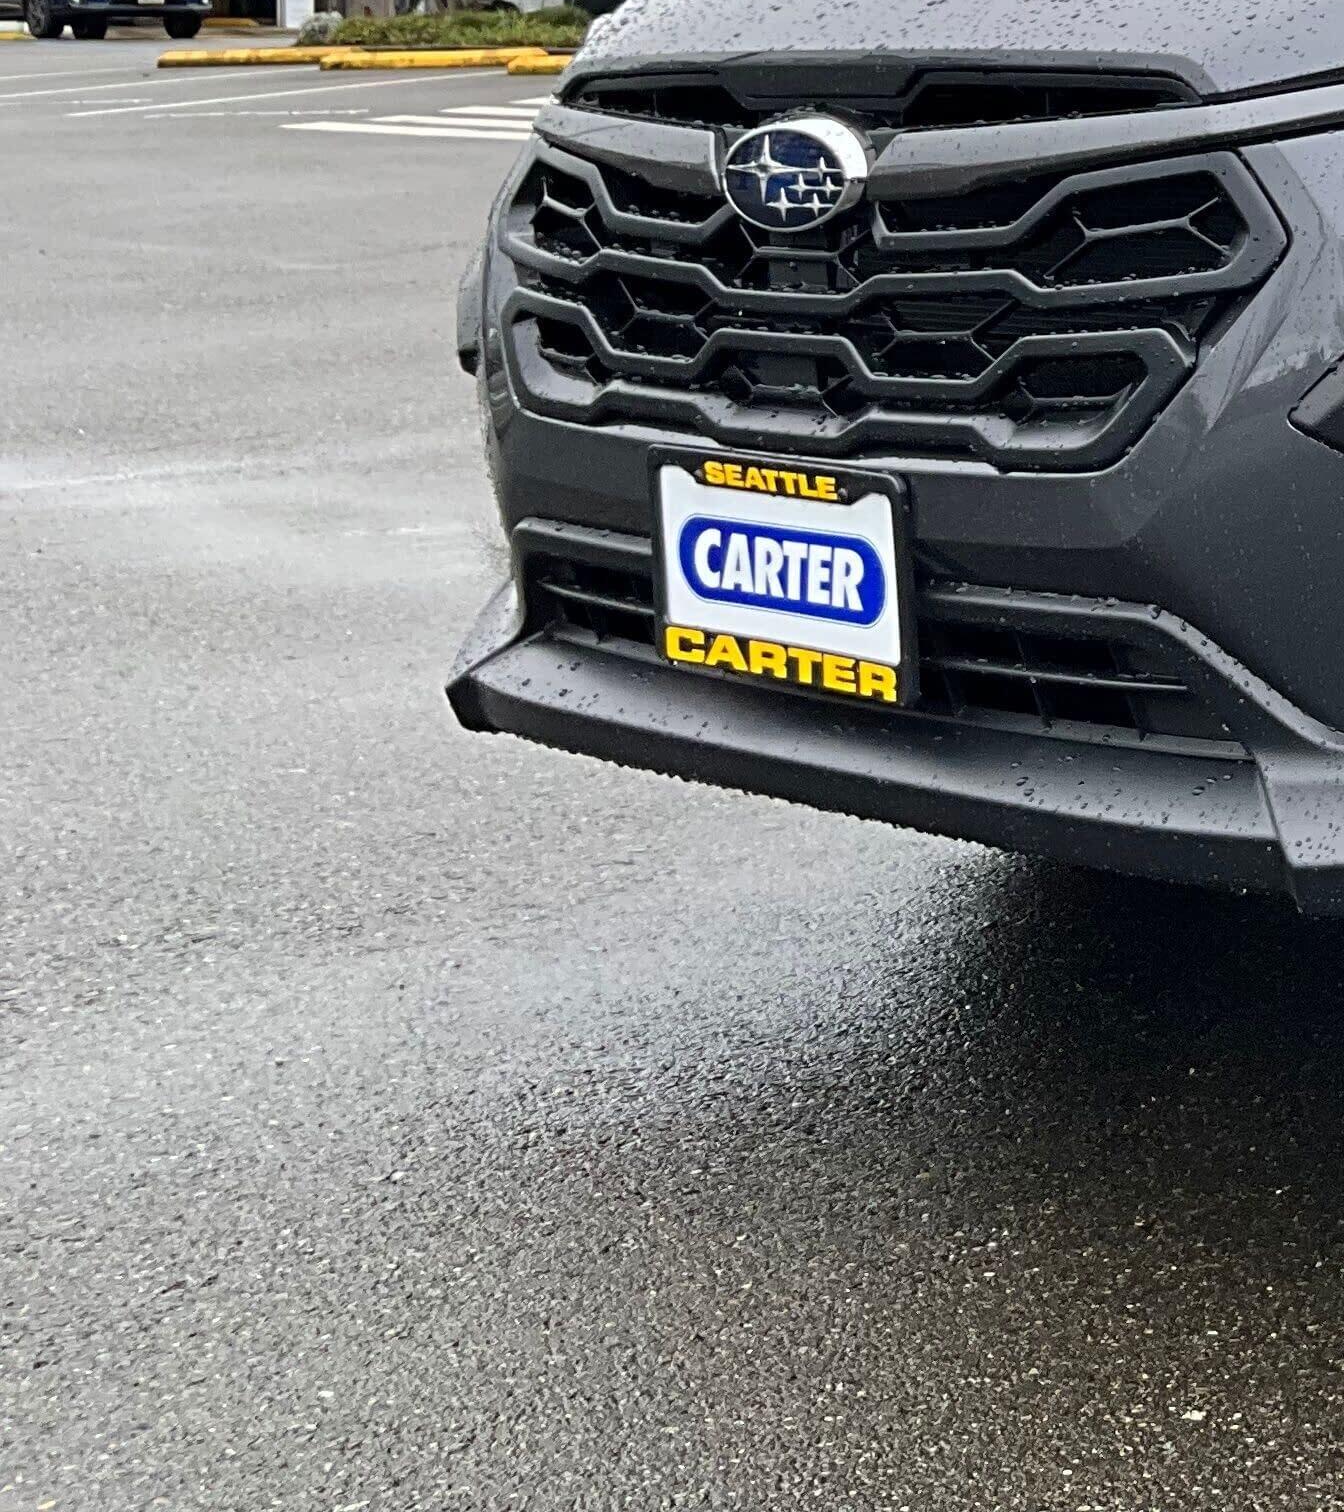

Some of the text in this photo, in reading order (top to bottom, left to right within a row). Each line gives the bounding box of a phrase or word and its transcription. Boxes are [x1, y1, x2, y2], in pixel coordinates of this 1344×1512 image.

[704, 461, 838, 500] SEATTLE
[694, 528, 865, 611] CARTER
[665, 626, 897, 702] CARTER
